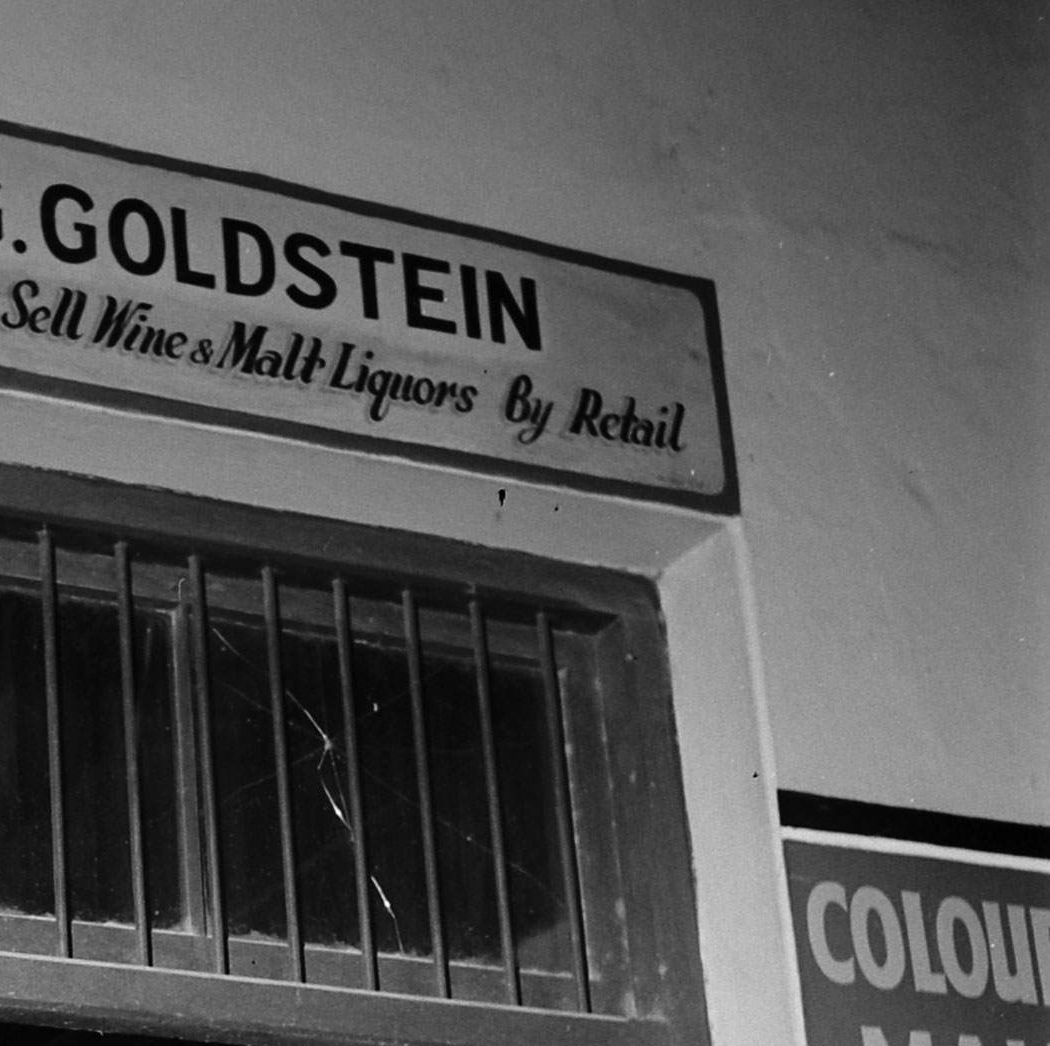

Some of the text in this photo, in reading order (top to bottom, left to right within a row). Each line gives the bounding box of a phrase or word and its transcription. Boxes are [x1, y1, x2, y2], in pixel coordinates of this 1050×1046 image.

[1, 279, 87, 341] Sell
[92, 295, 188, 359] Wine
[189, 338, 214, 364] &
[216, 321, 327, 384] Malt
[330, 342, 478, 422] Liquors
[505, 374, 553, 445] By
[569, 387, 686, 452] Retail
